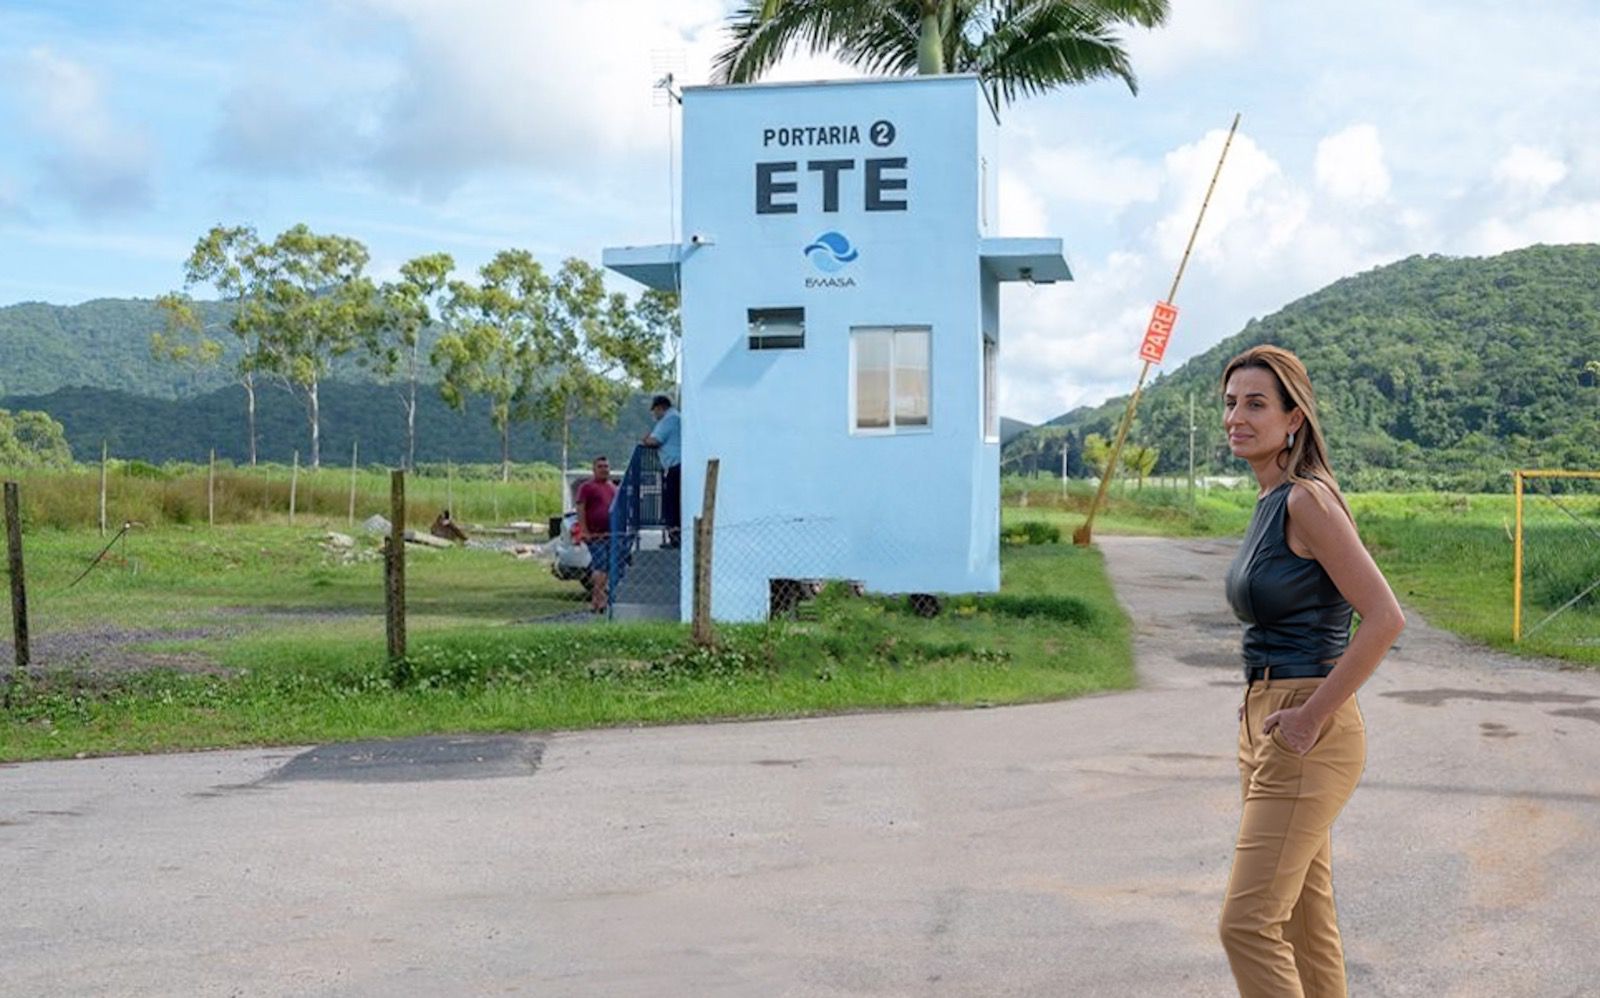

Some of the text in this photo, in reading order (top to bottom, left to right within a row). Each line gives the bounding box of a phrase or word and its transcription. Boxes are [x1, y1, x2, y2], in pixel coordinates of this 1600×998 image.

[764, 123, 890, 147] PORTARIA 2
[756, 157, 908, 214] ETE
[804, 277, 856, 288] EMASA
[1142, 306, 1175, 359] PARE
